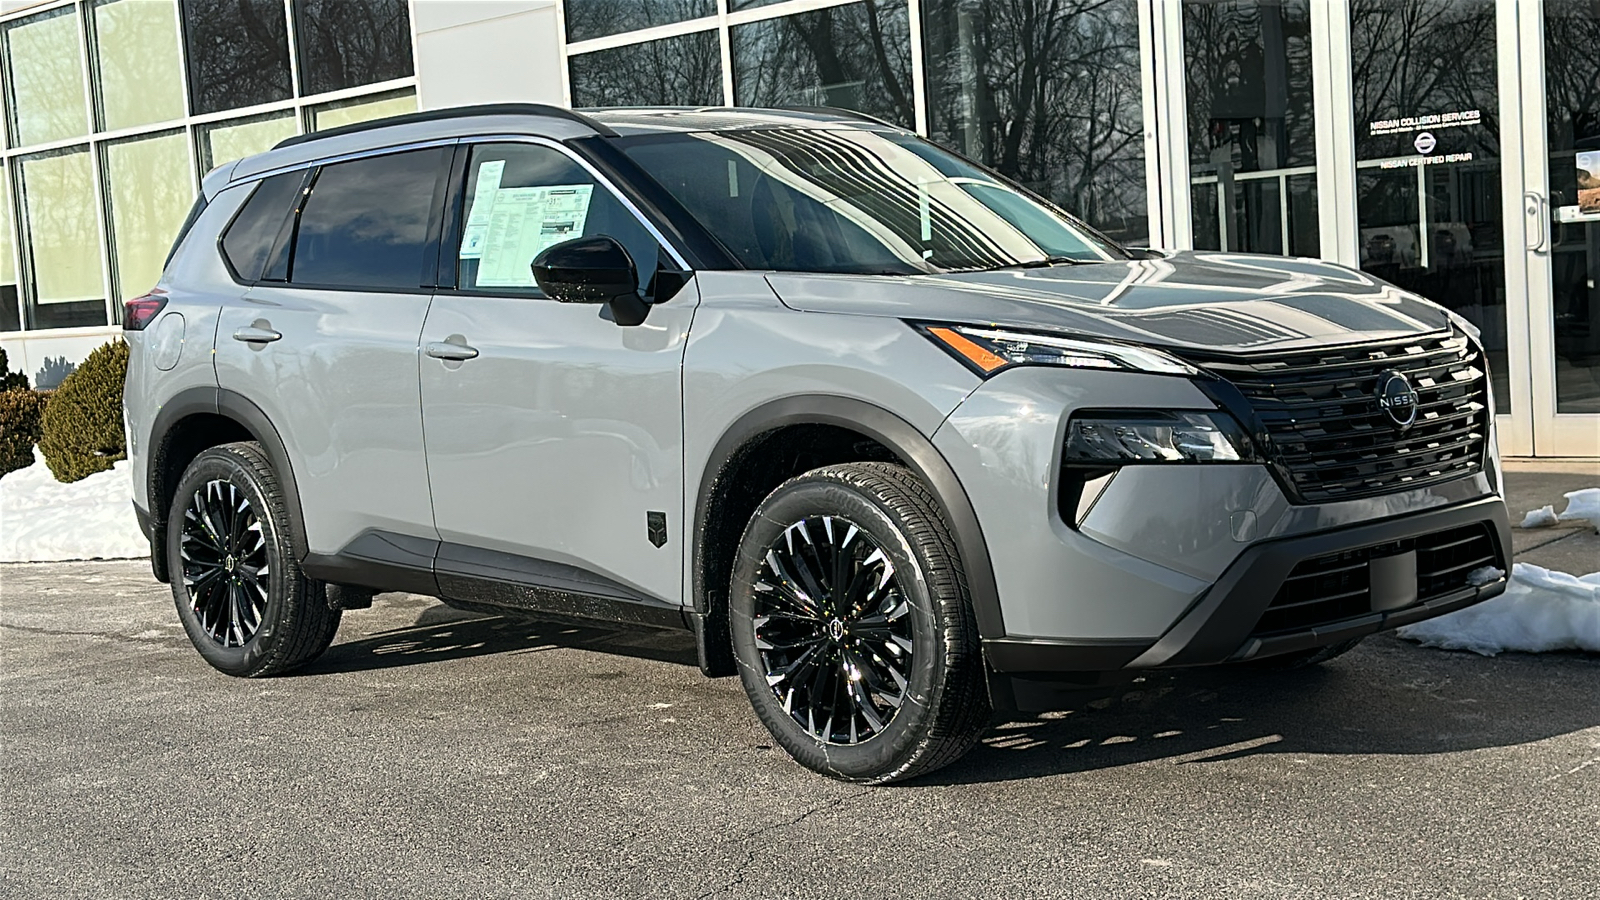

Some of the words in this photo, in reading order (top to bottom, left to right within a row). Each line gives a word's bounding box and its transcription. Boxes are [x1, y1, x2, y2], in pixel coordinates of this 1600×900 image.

[1370, 119, 1399, 130] NISSAN
[1401, 114, 1440, 127] COLLISION
[1442, 110, 1480, 122] SERVICES
[1380, 160, 1408, 170] NISSAN
[1409, 155, 1445, 167] CERTIFIED
[1446, 152, 1473, 163] REPAIR
[1380, 395, 1414, 407] NISS
